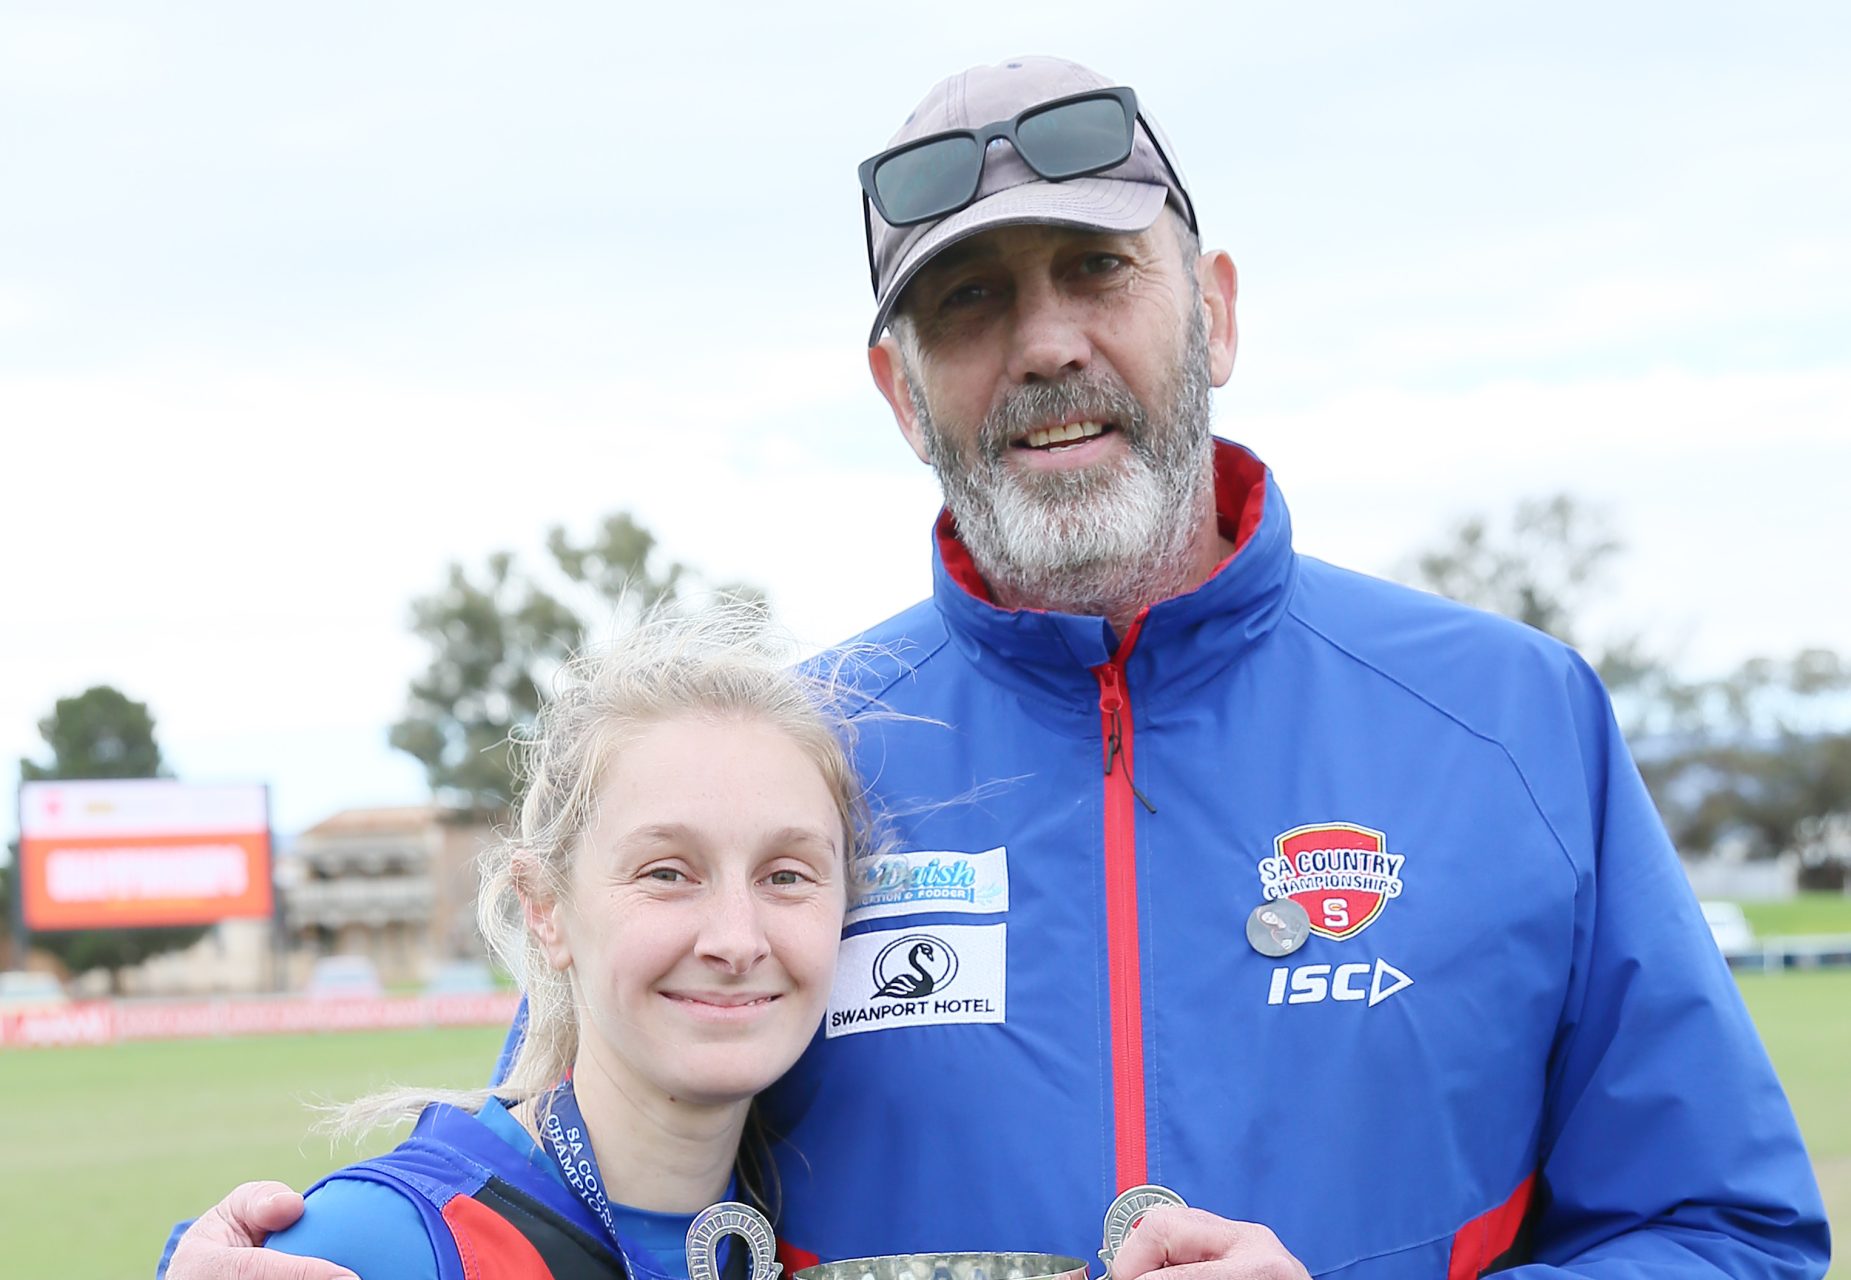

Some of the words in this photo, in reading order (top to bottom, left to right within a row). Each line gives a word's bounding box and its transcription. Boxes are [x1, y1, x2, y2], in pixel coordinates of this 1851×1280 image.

[1261, 858, 1293, 881] SA
[1298, 851, 1400, 877] COUNTRY
[918, 888, 967, 899] FODDER
[1267, 874, 1399, 899] CHAMPIONSHIPS
[1267, 963, 1371, 1005] ISC
[831, 1000, 929, 1027] SWANPORT
[934, 998, 996, 1015] HOTEL
[566, 1127, 584, 1157] SA
